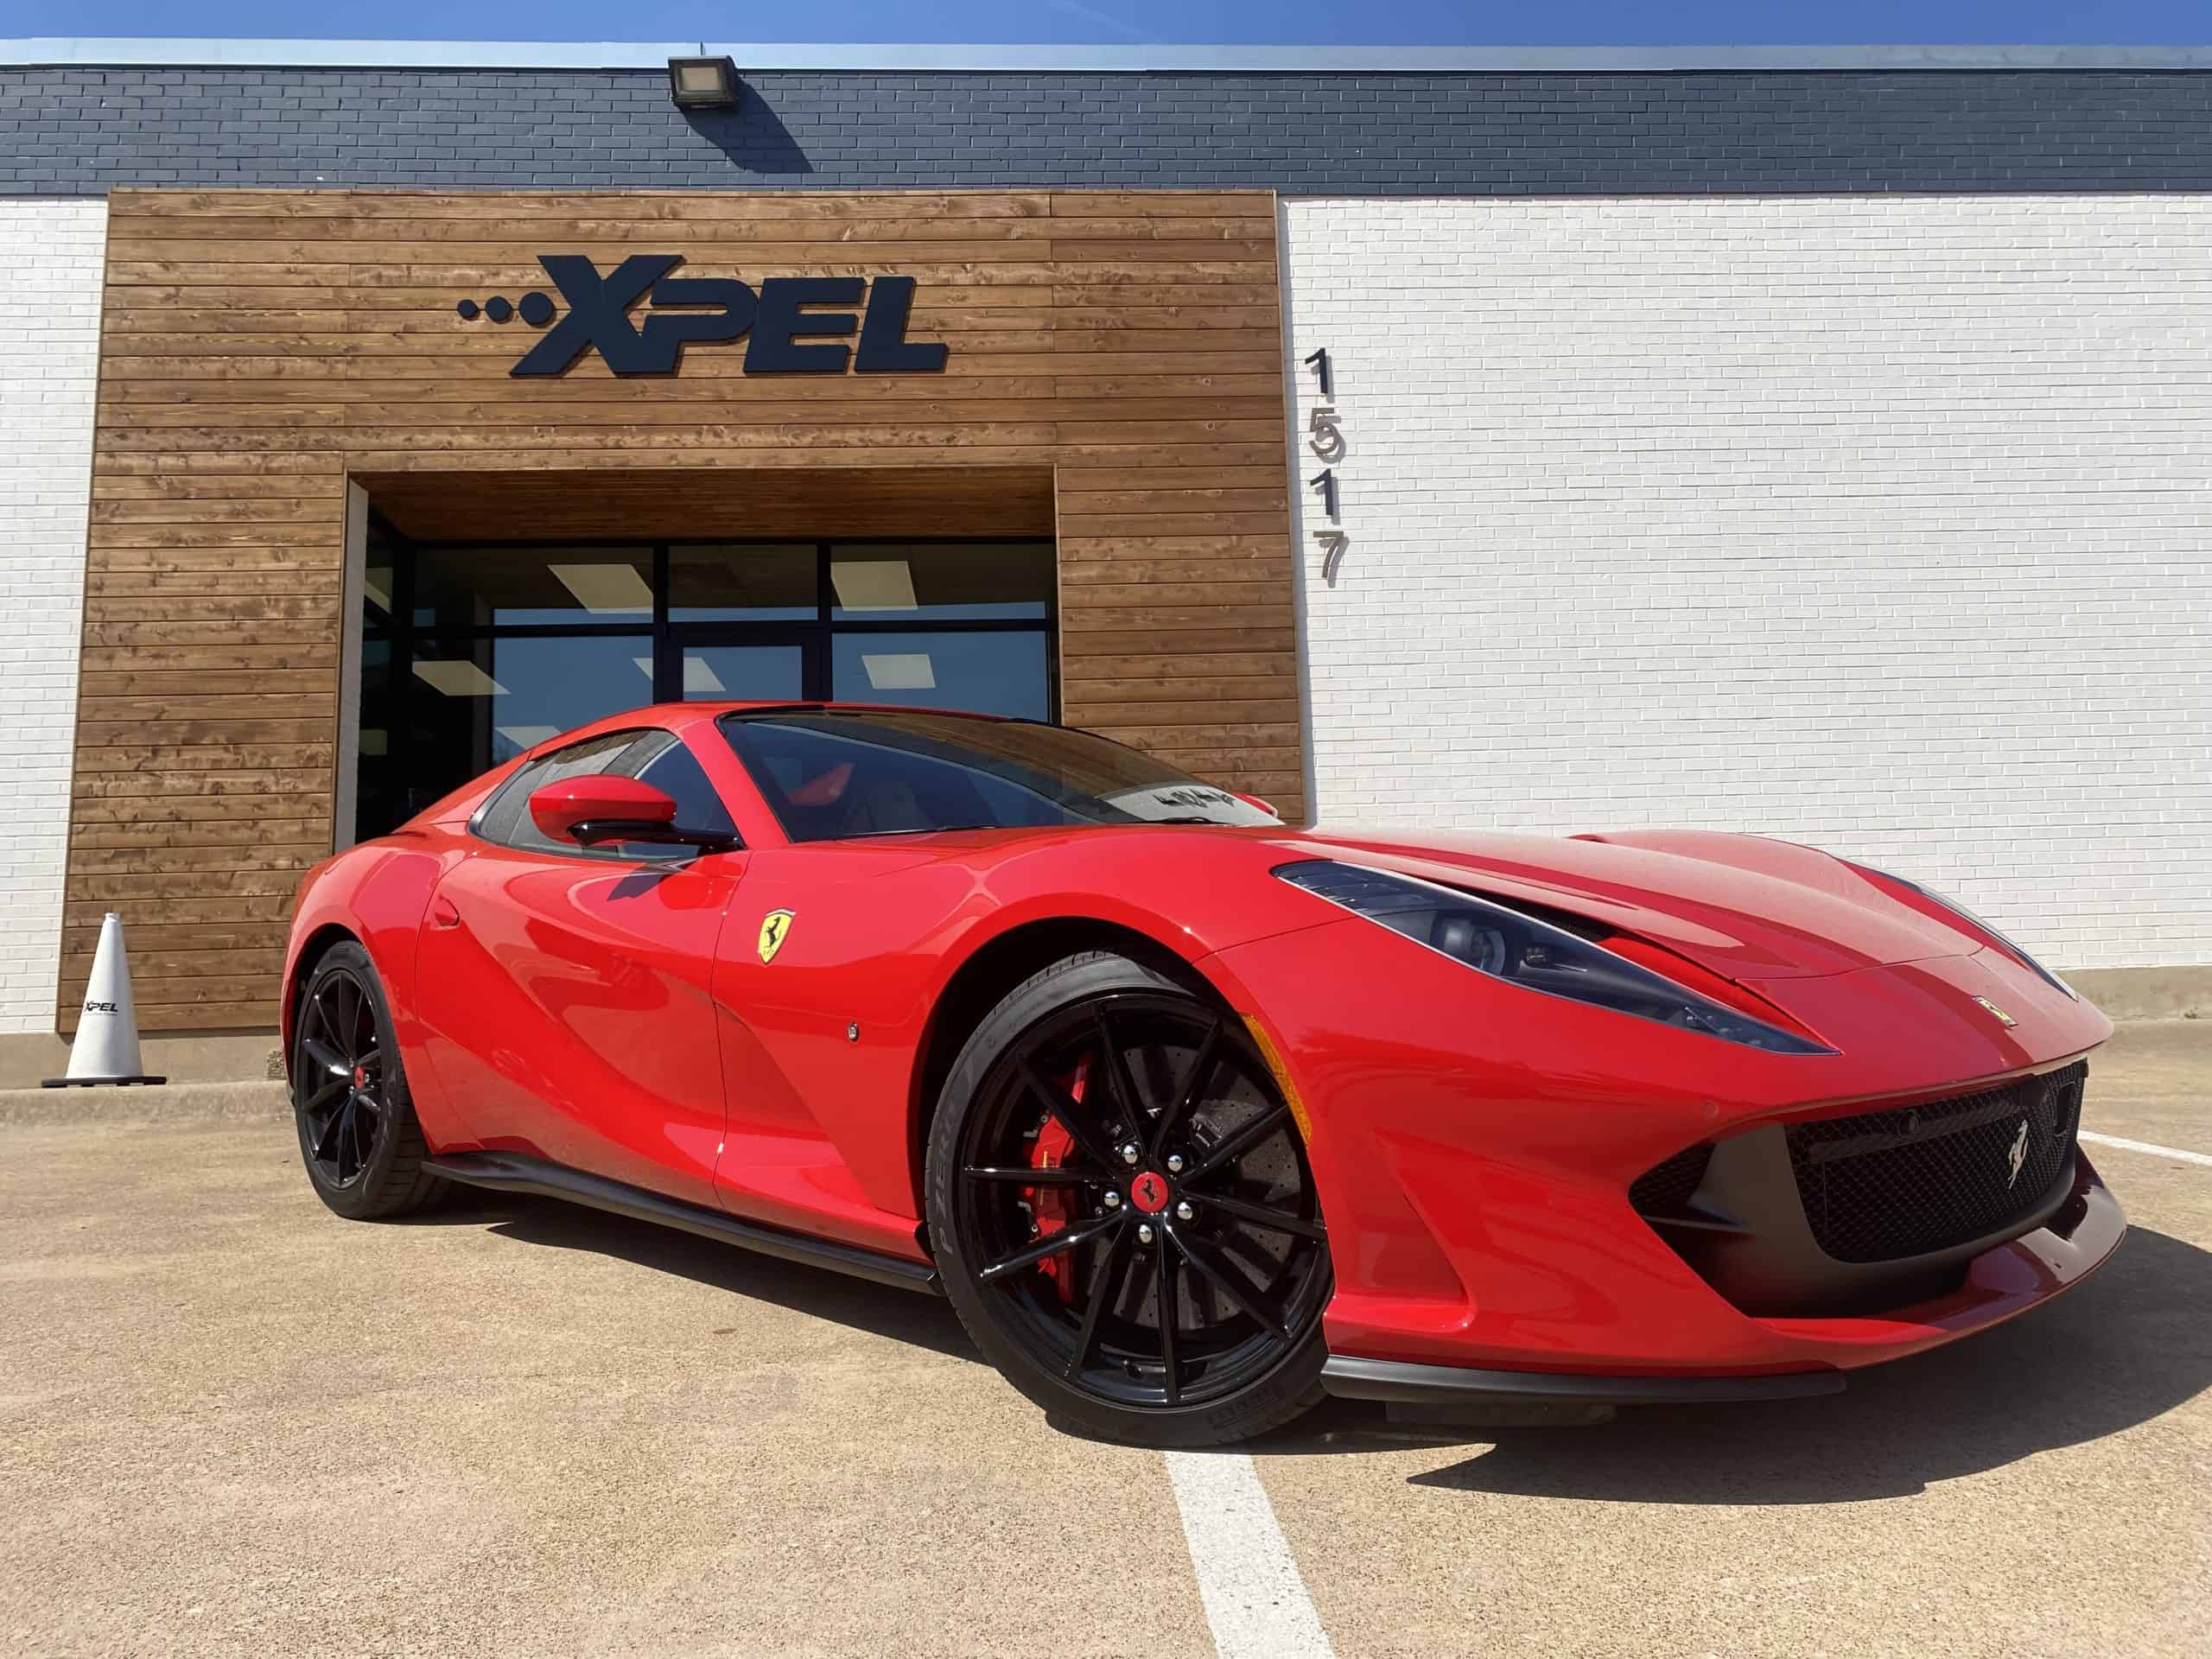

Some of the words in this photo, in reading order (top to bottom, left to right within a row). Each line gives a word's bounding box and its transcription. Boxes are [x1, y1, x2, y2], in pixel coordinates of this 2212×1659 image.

[509, 254, 946, 376] XPEL
[1305, 347, 1346, 580] 1517
[84, 1001, 118, 1012] XPEL
